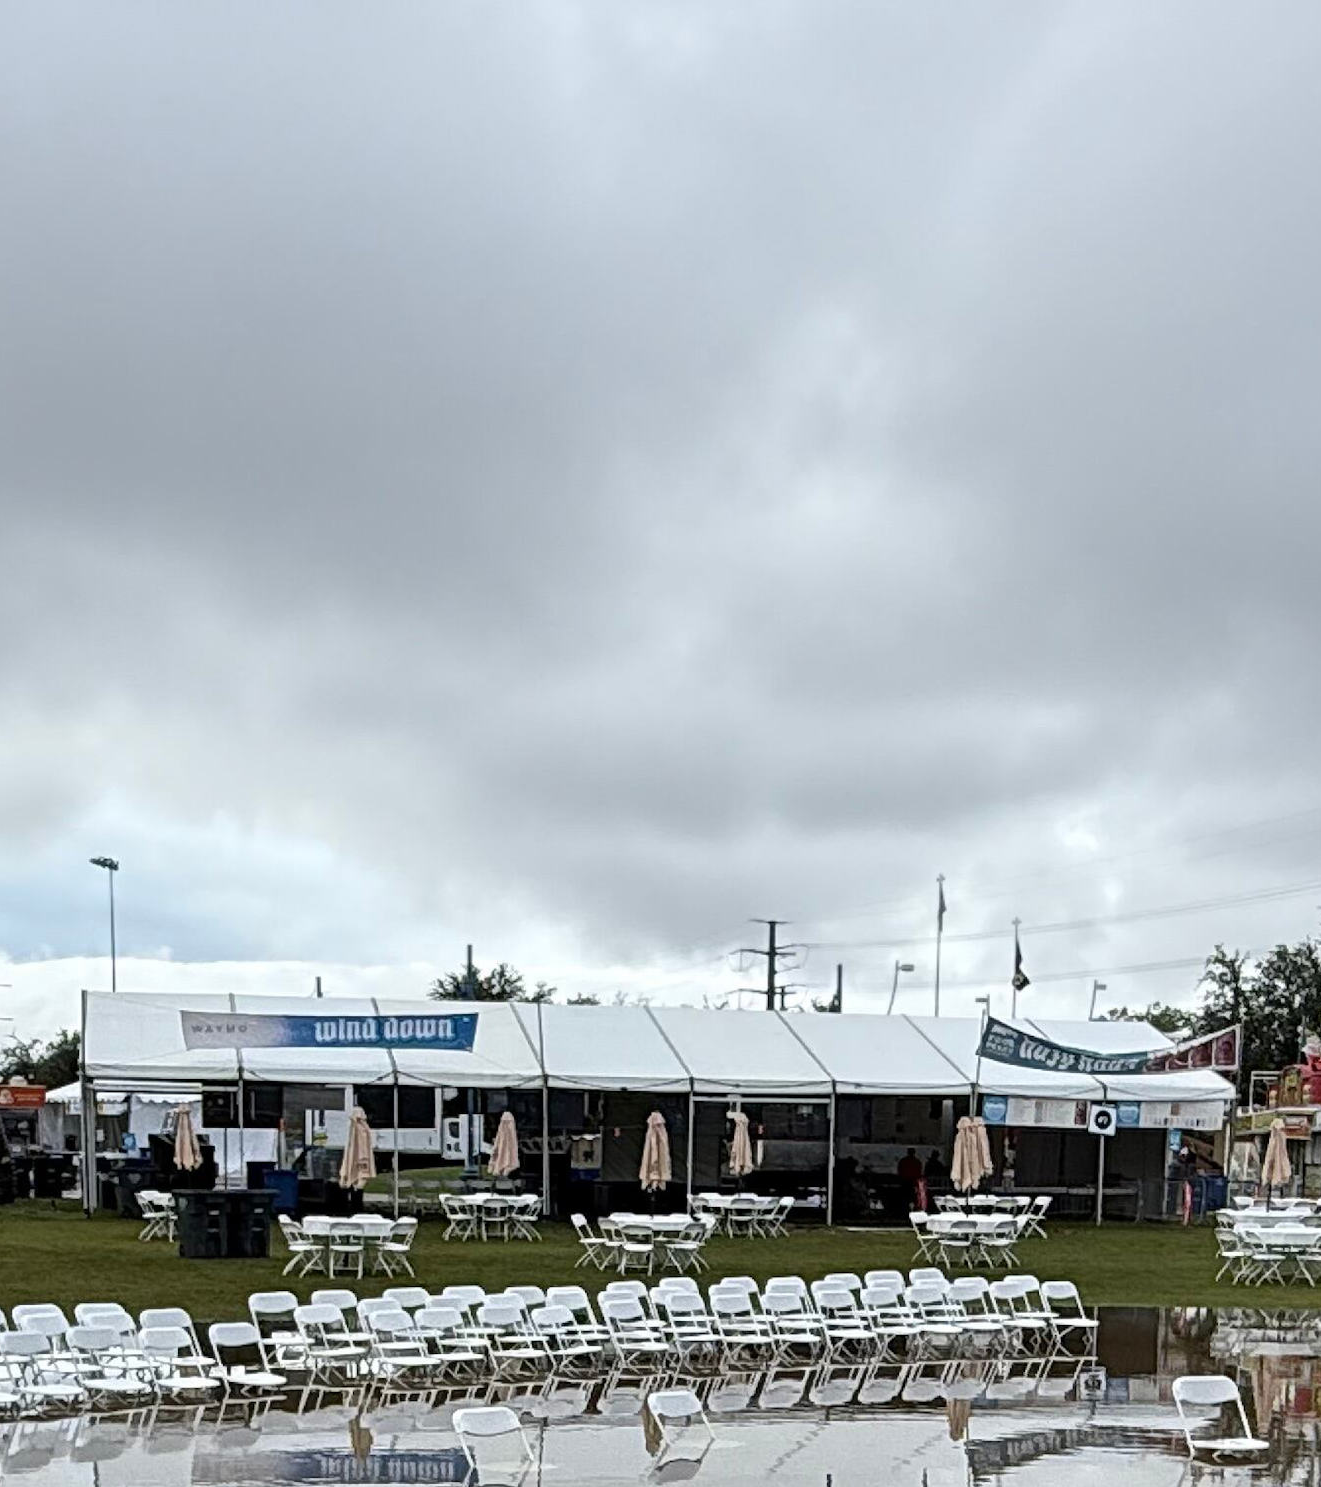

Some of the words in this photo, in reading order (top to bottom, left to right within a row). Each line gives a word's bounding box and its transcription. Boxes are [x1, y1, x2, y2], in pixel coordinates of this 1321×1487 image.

[192, 1024, 247, 1034] WAYMO
[314, 1017, 378, 1043] wind
[383, 1017, 454, 1041] down
